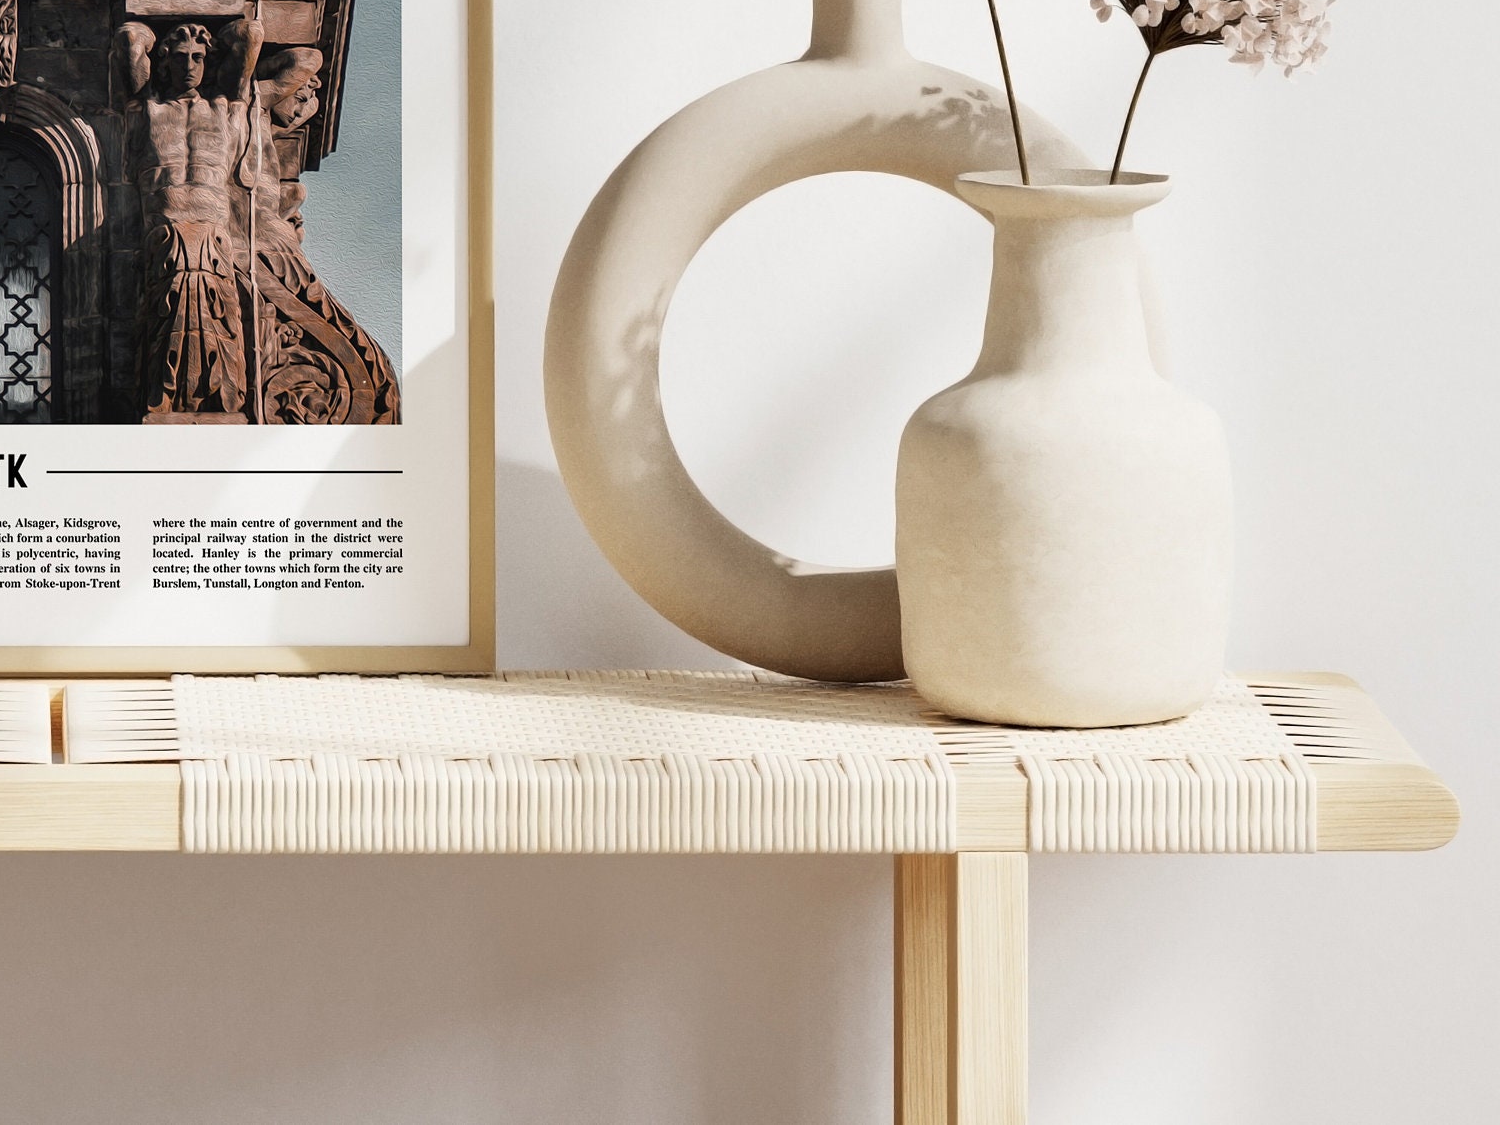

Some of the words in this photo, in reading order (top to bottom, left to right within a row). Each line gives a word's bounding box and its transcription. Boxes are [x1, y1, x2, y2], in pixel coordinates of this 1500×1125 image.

[14, 518, 60, 530] Alsager,
[63, 518, 121, 530] Kidsgrove,
[152, 518, 186, 527] where
[189, 518, 207, 527] the
[210, 518, 238, 527] main
[241, 519, 276, 527] centre
[278, 518, 291, 527] of
[293, 519, 358, 530] government
[361, 518, 382, 527] and
[386, 518, 404, 527] the
[16, 533, 44, 542] form
[55, 533, 121, 542] conurbation
[152, 533, 201, 545] principal
[206, 533, 247, 545] railway
[252, 533, 289, 542] station
[294, 533, 306, 542] in
[310, 533, 328, 542] the
[333, 533, 372, 543] district
[1, 548, 11, 558] is
[16, 548, 79, 560] polycentric,
[84, 548, 121, 560] having
[152, 548, 194, 558] located.
[201, 548, 240, 560] Hanley
[247, 548, 257, 558] is
[263, 549, 282, 558] the
[288, 548, 334, 560] primary
[340, 548, 404, 558] commercial
[39, 564, 52, 573] of
[54, 563, 71, 573] six
[74, 565, 106, 573] towns
[109, 564, 121, 573] in
[152, 565, 190, 574] centre;
[193, 564, 211, 573] the
[212, 564, 242, 573] other
[244, 565, 276, 573] towns
[278, 564, 311, 573] which
[313, 563, 340, 573] form
[343, 563, 361, 573] the
[362, 563, 383, 575] city
[25, 579, 121, 590] Stoke-upon-Trent
[152, 579, 201, 590] Burslem,
[202, 579, 251, 589] Tunstall,
[253, 579, 299, 590] Longton
[300, 579, 322, 588] and
[324, 579, 365, 588] Fenton.
